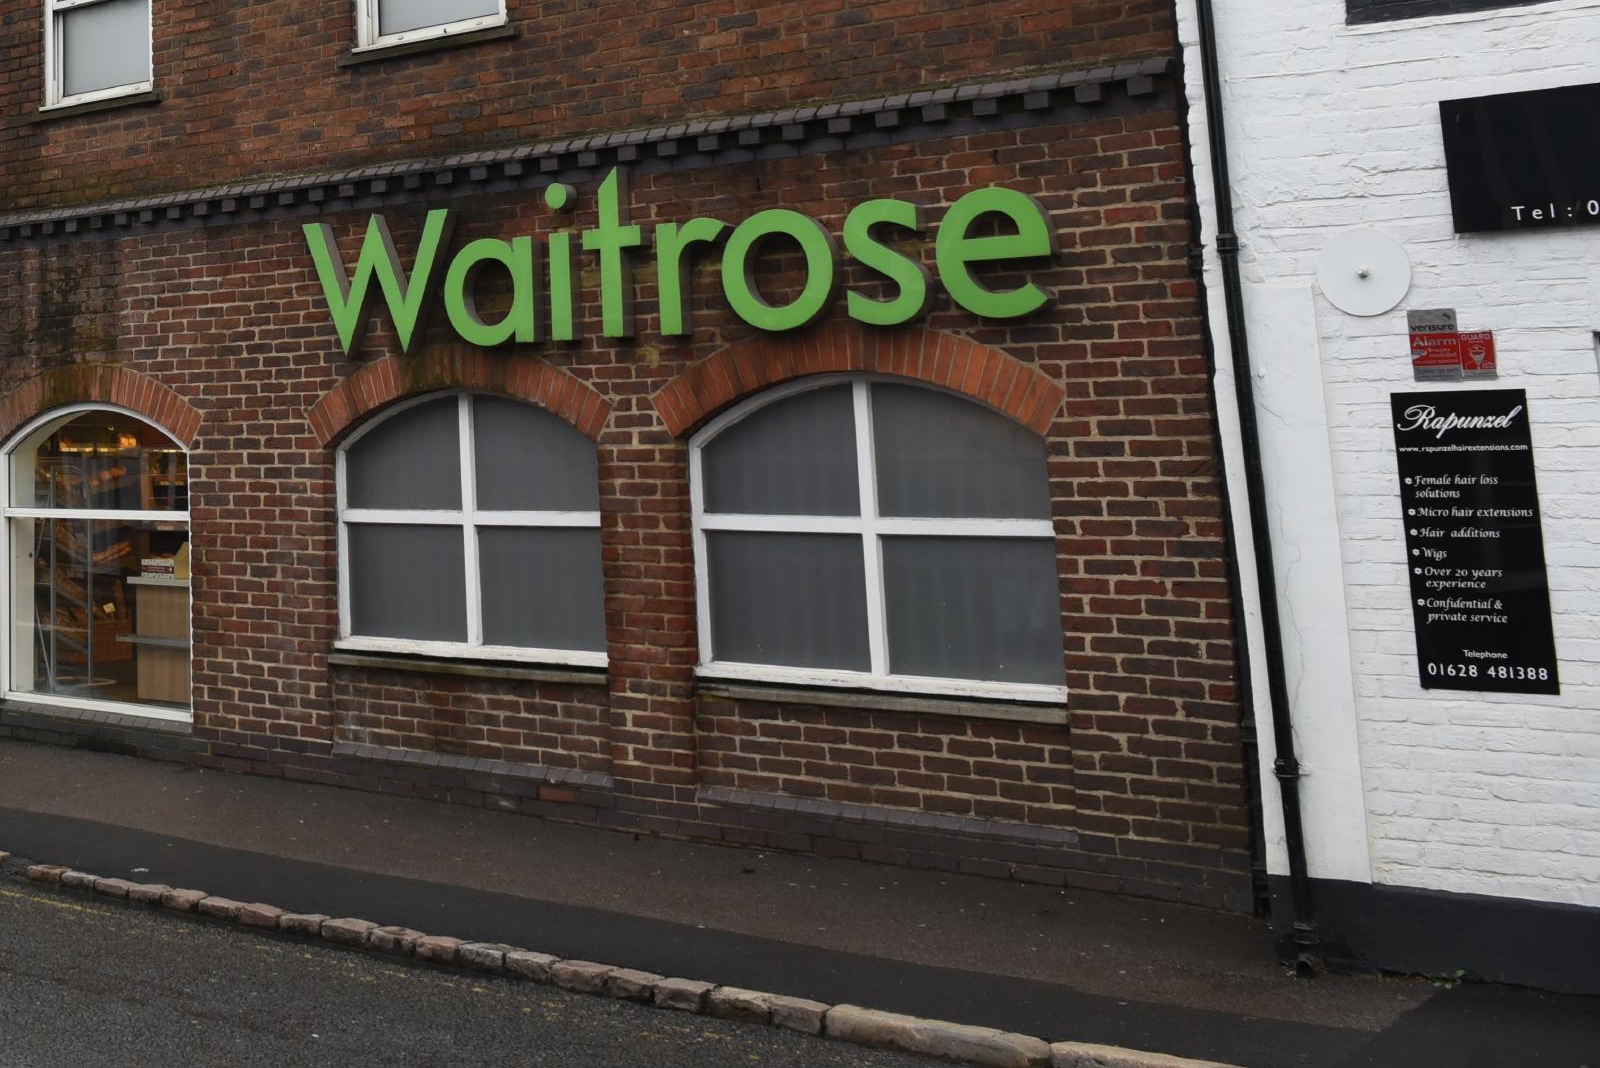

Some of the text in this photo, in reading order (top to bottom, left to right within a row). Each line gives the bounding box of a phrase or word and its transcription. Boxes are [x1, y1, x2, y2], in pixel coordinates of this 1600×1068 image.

[1510, 203, 1573, 220] Tel:
[302, 166, 1058, 357] Waitrose
[1410, 323, 1455, 332] verisure
[1412, 335, 1457, 347] Alarm
[1460, 333, 1491, 341] GUARD
[1397, 404, 1523, 439] Rapunzel
[1398, 443, 1529, 454] www.rapunzelhairextensions.com
[1413, 474, 1499, 487] Female hair loss
[1415, 487, 1461, 499] solutions
[1417, 506, 1534, 518] Micro hair extensions
[1419, 527, 1501, 538] Hair additions
[1422, 547, 1448, 561] Wigs
[1424, 566, 1503, 580] Over 20 years
[1425, 579, 1487, 591] experience
[1426, 597, 1503, 611] Confidential &
[1426, 611, 1508, 624] private service
[1462, 649, 1508, 660] Telephone
[1427, 662, 1549, 681] 01628 481388
